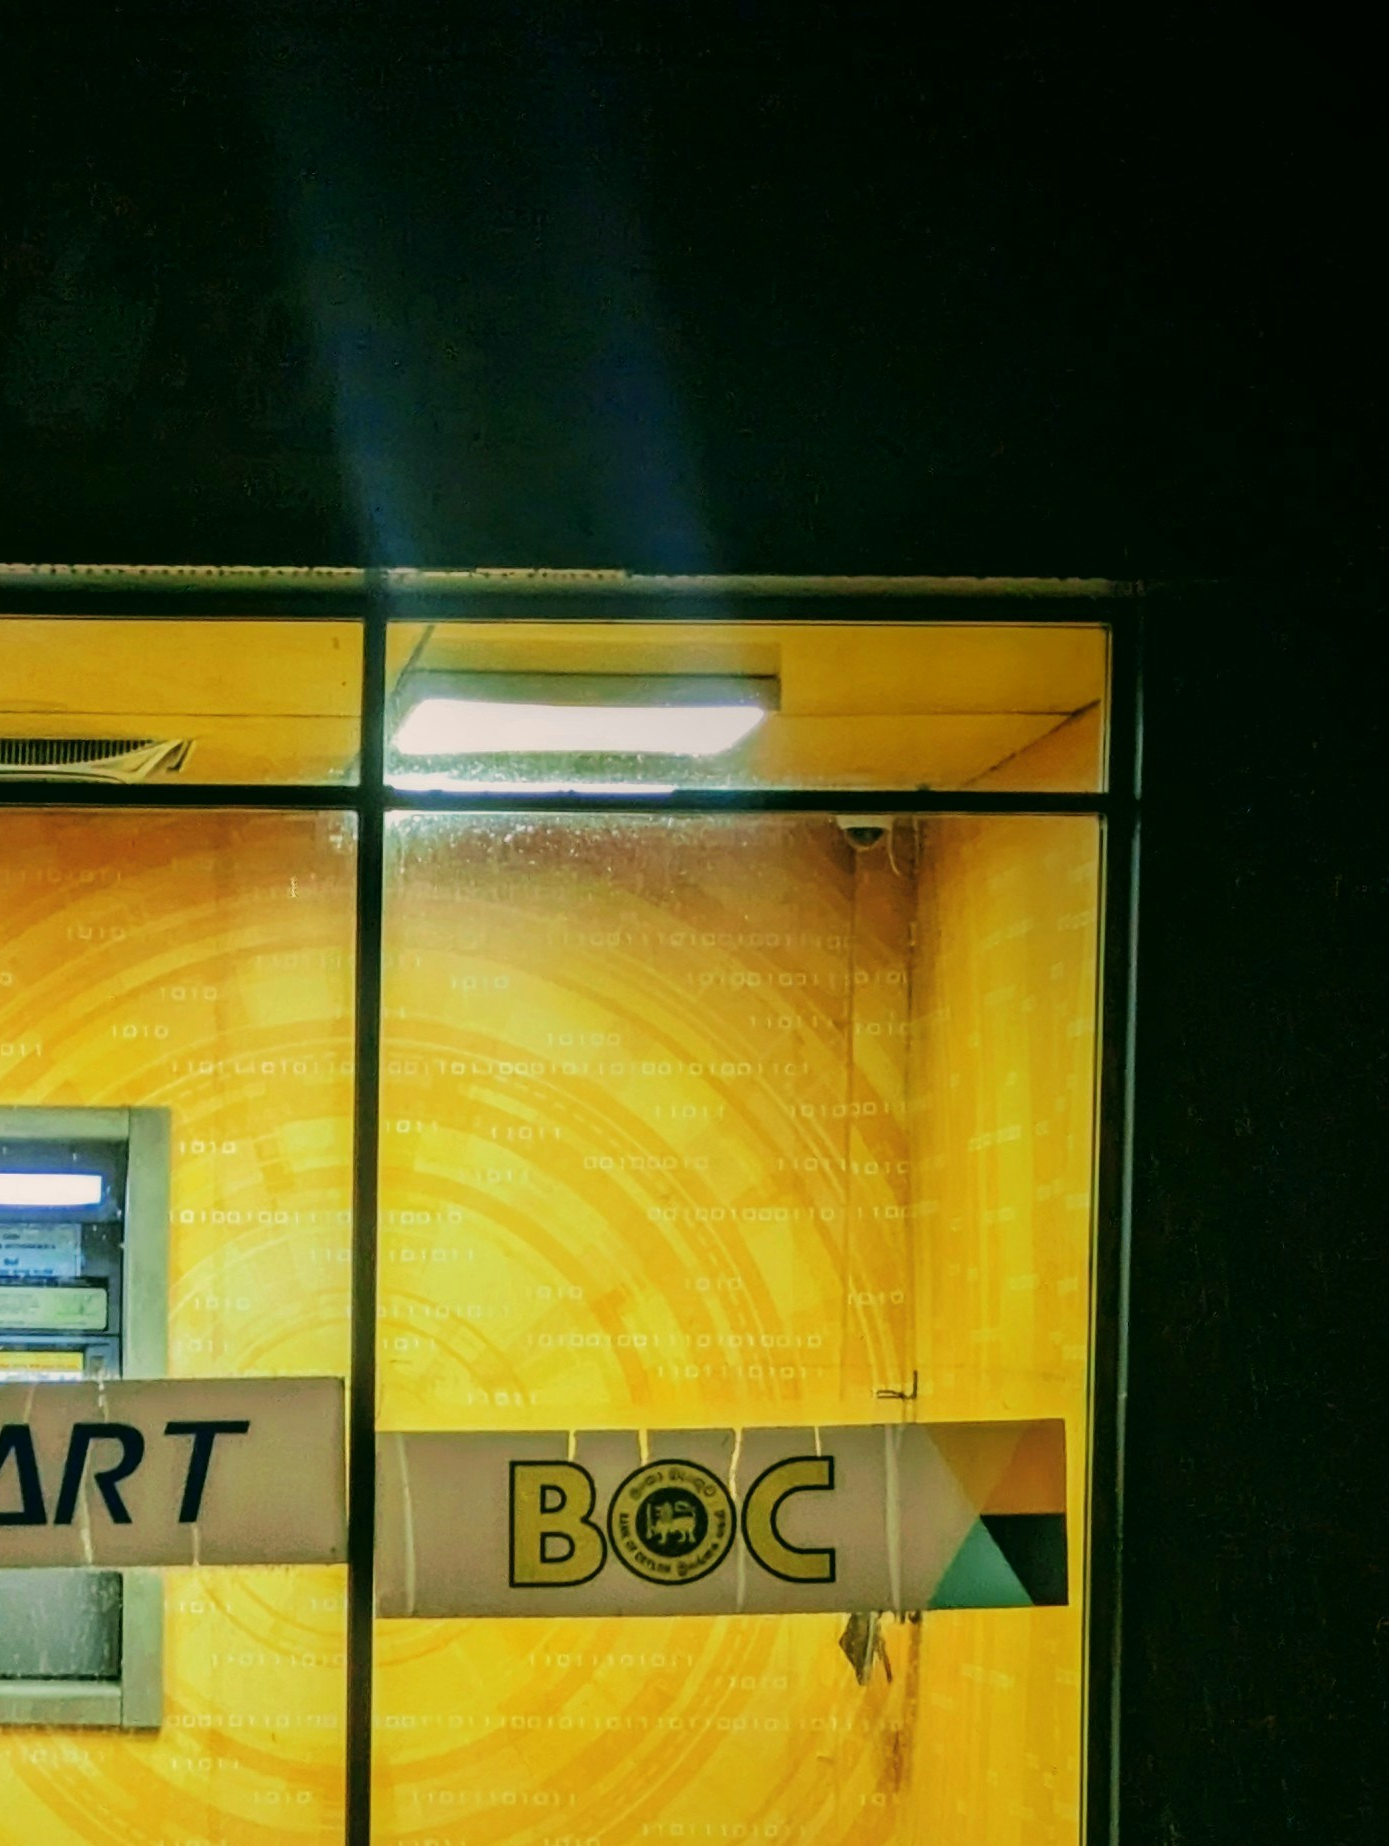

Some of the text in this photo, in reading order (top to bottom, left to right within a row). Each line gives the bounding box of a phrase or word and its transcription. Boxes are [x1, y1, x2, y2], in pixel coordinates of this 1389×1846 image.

[66, 926, 127, 941] 1010
[450, 975, 510, 990] 1010
[161, 986, 217, 1001] 1010
[112, 1024, 169, 1039] 1010
[547, 1032, 621, 1046] 10100
[655, 1105, 724, 1119] 11011
[490, 1126, 562, 1141] 11011
[179, 1140, 237, 1155] 1010
[684, 1277, 742, 1291] 1010
[525, 1285, 583, 1300] 1010
[467, 1391, 537, 1406] 11011
[509, 1456, 835, 1588] BOC
[528, 1653, 692, 1668] 11011101011
[169, 1757, 240, 1771] 11011
[253, 1790, 311, 1805] 1010
